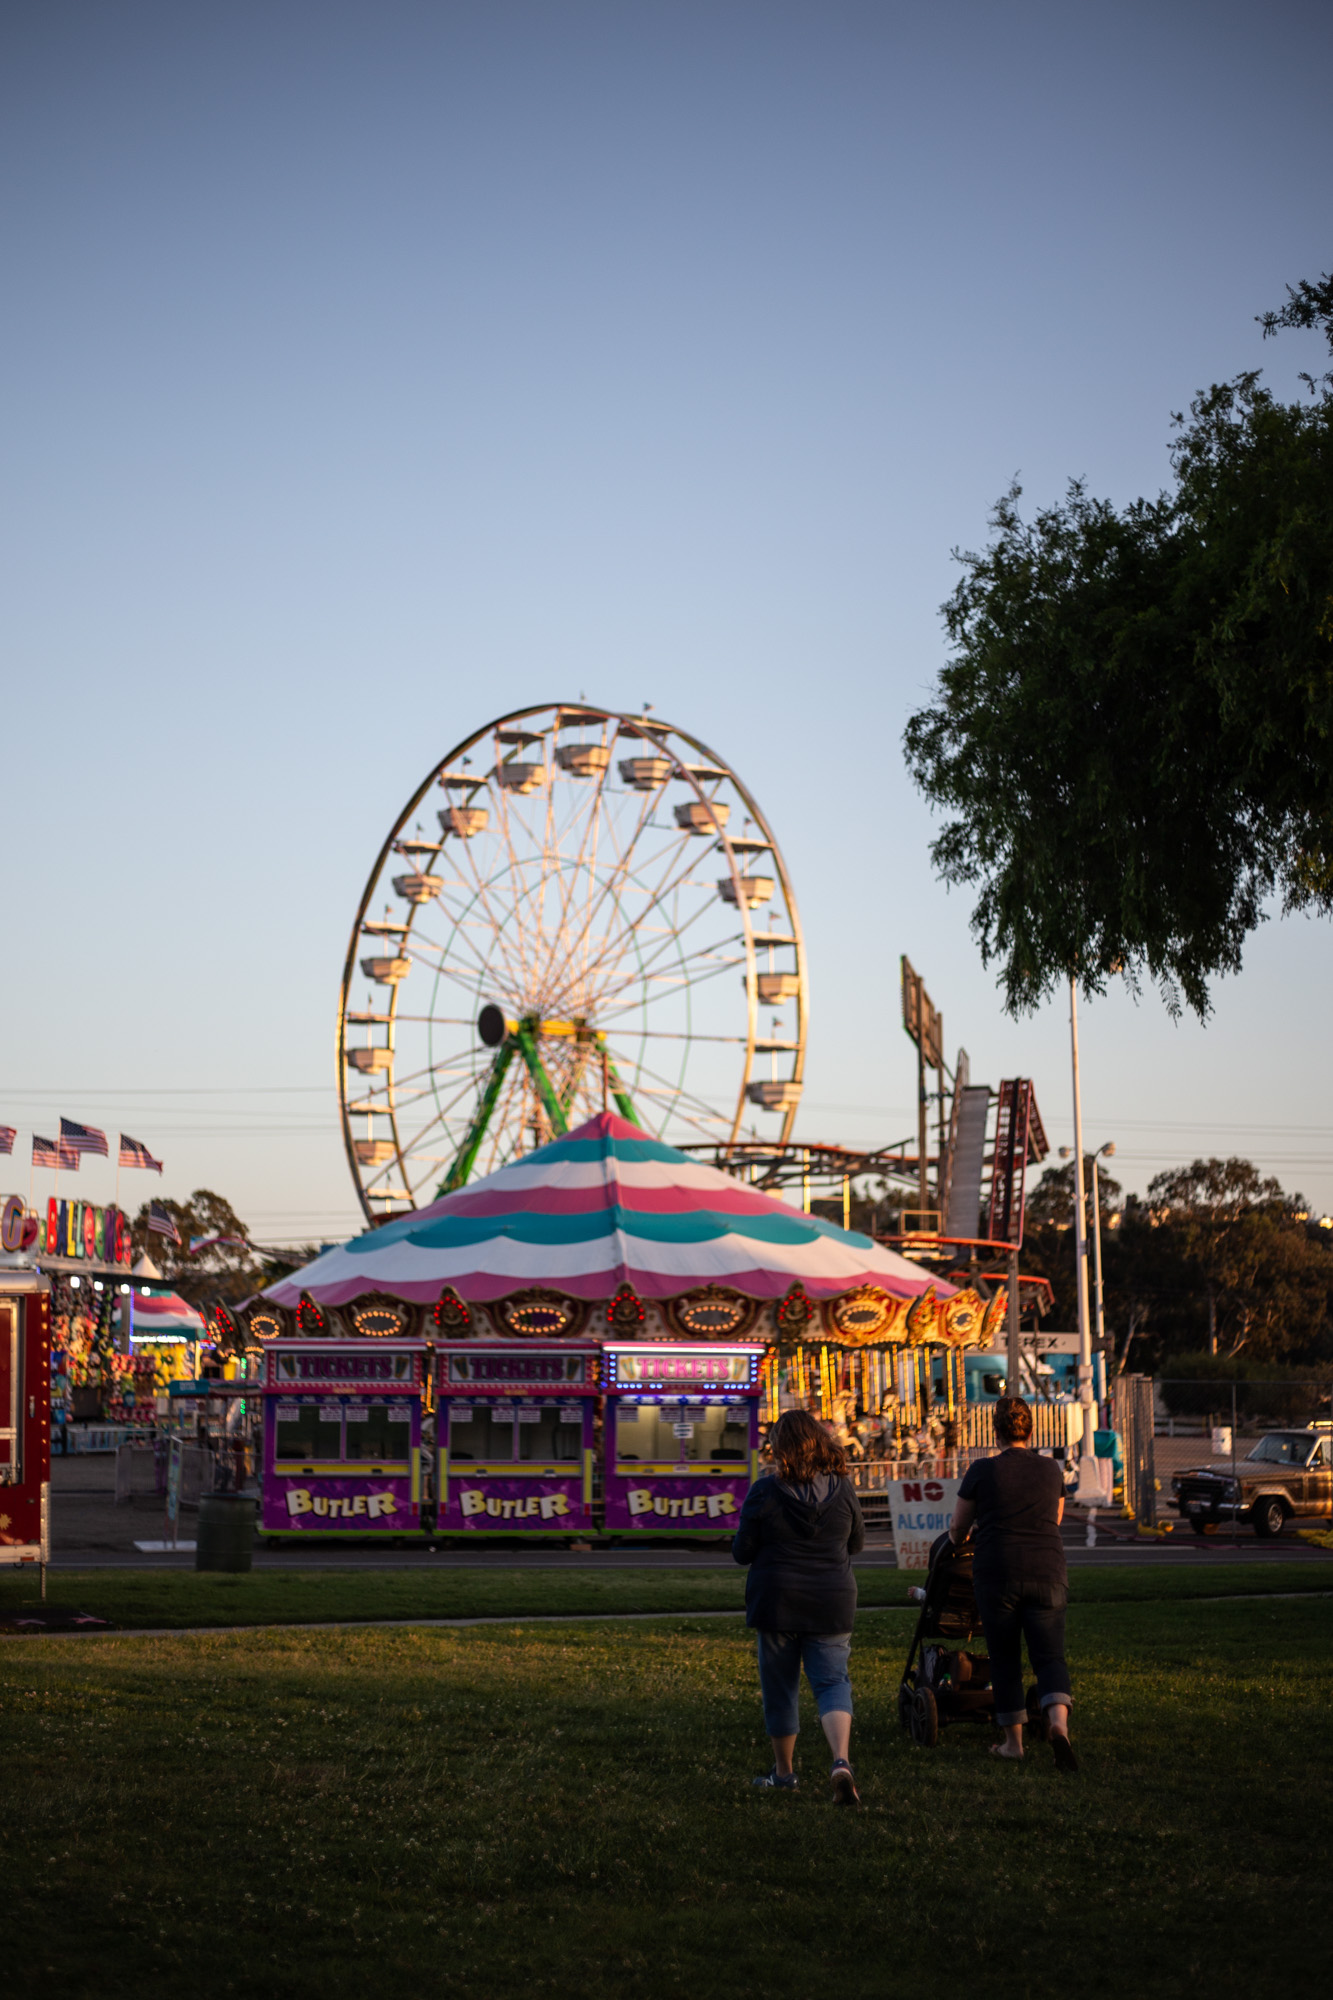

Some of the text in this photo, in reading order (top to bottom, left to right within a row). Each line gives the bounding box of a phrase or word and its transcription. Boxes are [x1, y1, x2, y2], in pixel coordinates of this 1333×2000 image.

[46, 1197, 124, 1263] BALLOONS
[1001, 1335, 1058, 1349] TREX
[296, 1355, 393, 1379] TICKETS
[470, 1357, 564, 1381] TICKETS
[637, 1357, 730, 1381] TICKETS
[285, 1488, 398, 1519] BUTLER
[626, 1488, 738, 1519] BUTLER
[902, 1481, 945, 1503] NO
[458, 1489, 571, 1520] BUTLER
[898, 1513, 953, 1530] ALCOHO
[900, 1541, 934, 1555] ALLO
